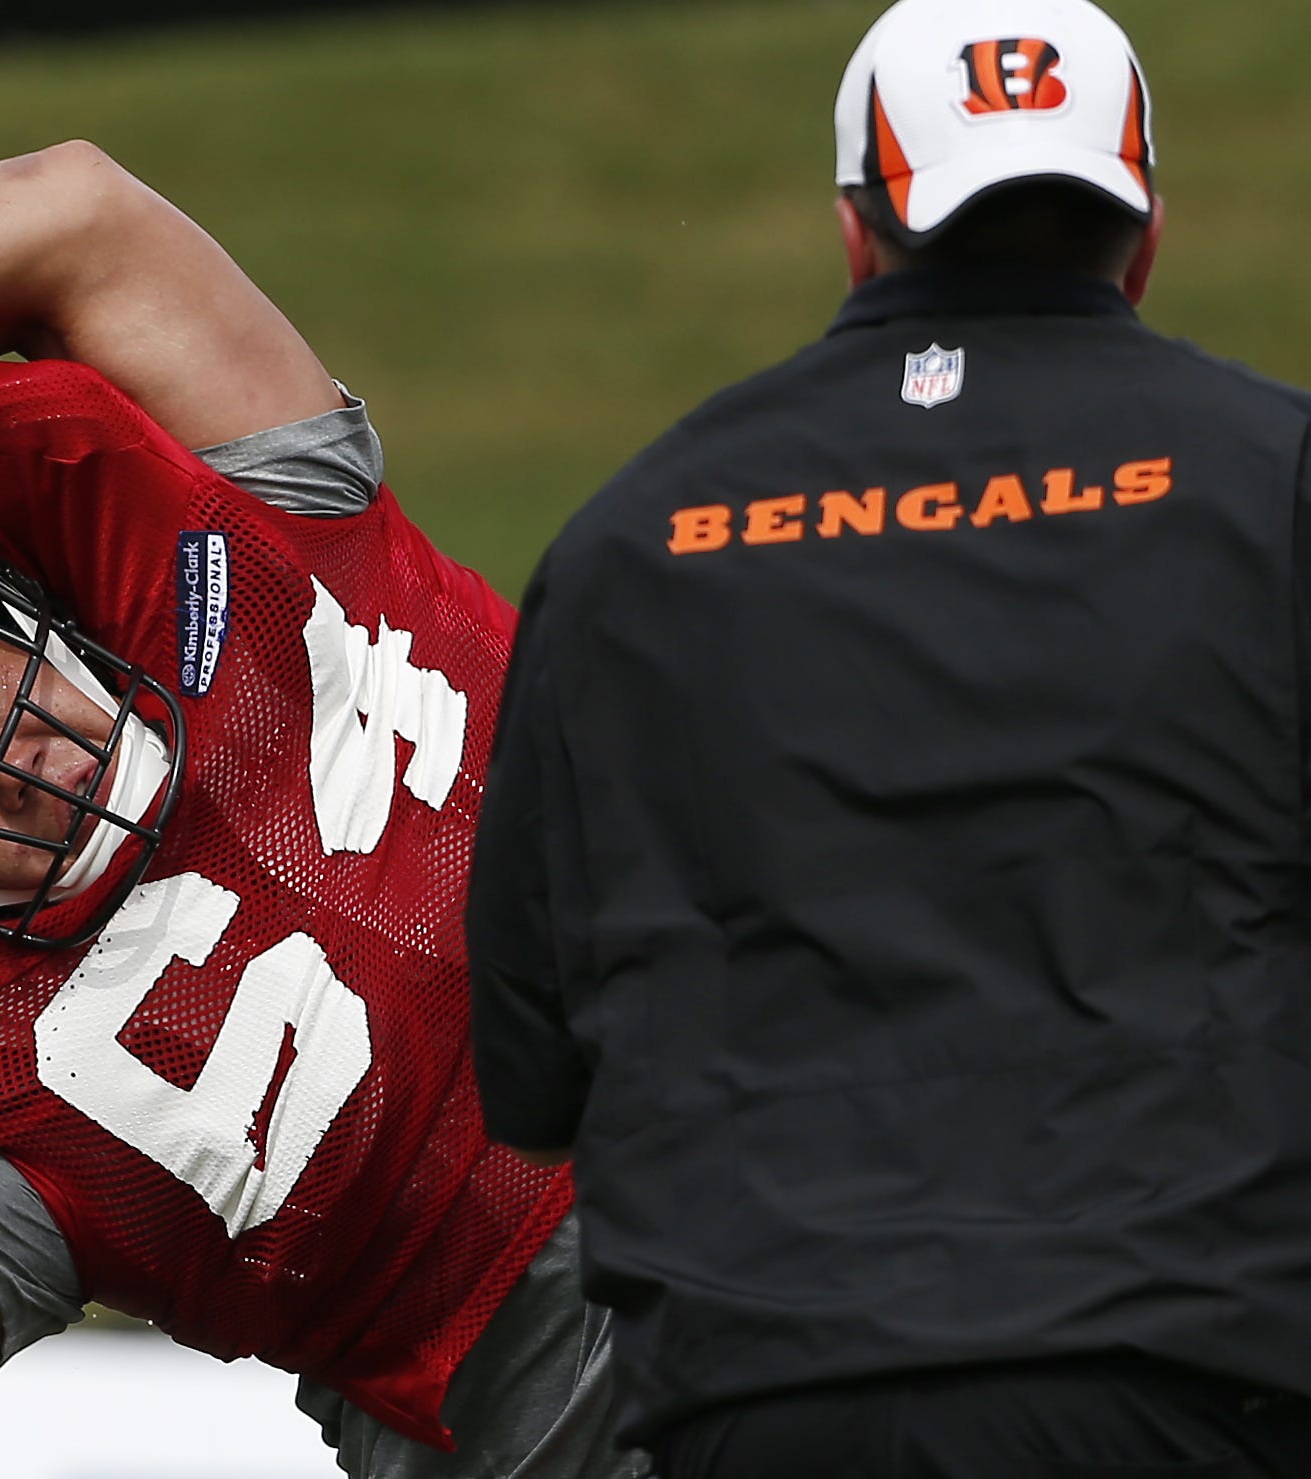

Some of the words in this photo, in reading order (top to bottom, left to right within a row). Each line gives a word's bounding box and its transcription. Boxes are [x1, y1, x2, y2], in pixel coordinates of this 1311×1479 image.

[959, 37, 1067, 115] B
[911, 375, 952, 397] NFL
[665, 456, 1173, 556] BENGALS
[182, 541, 204, 662] Kimberly-Clark
